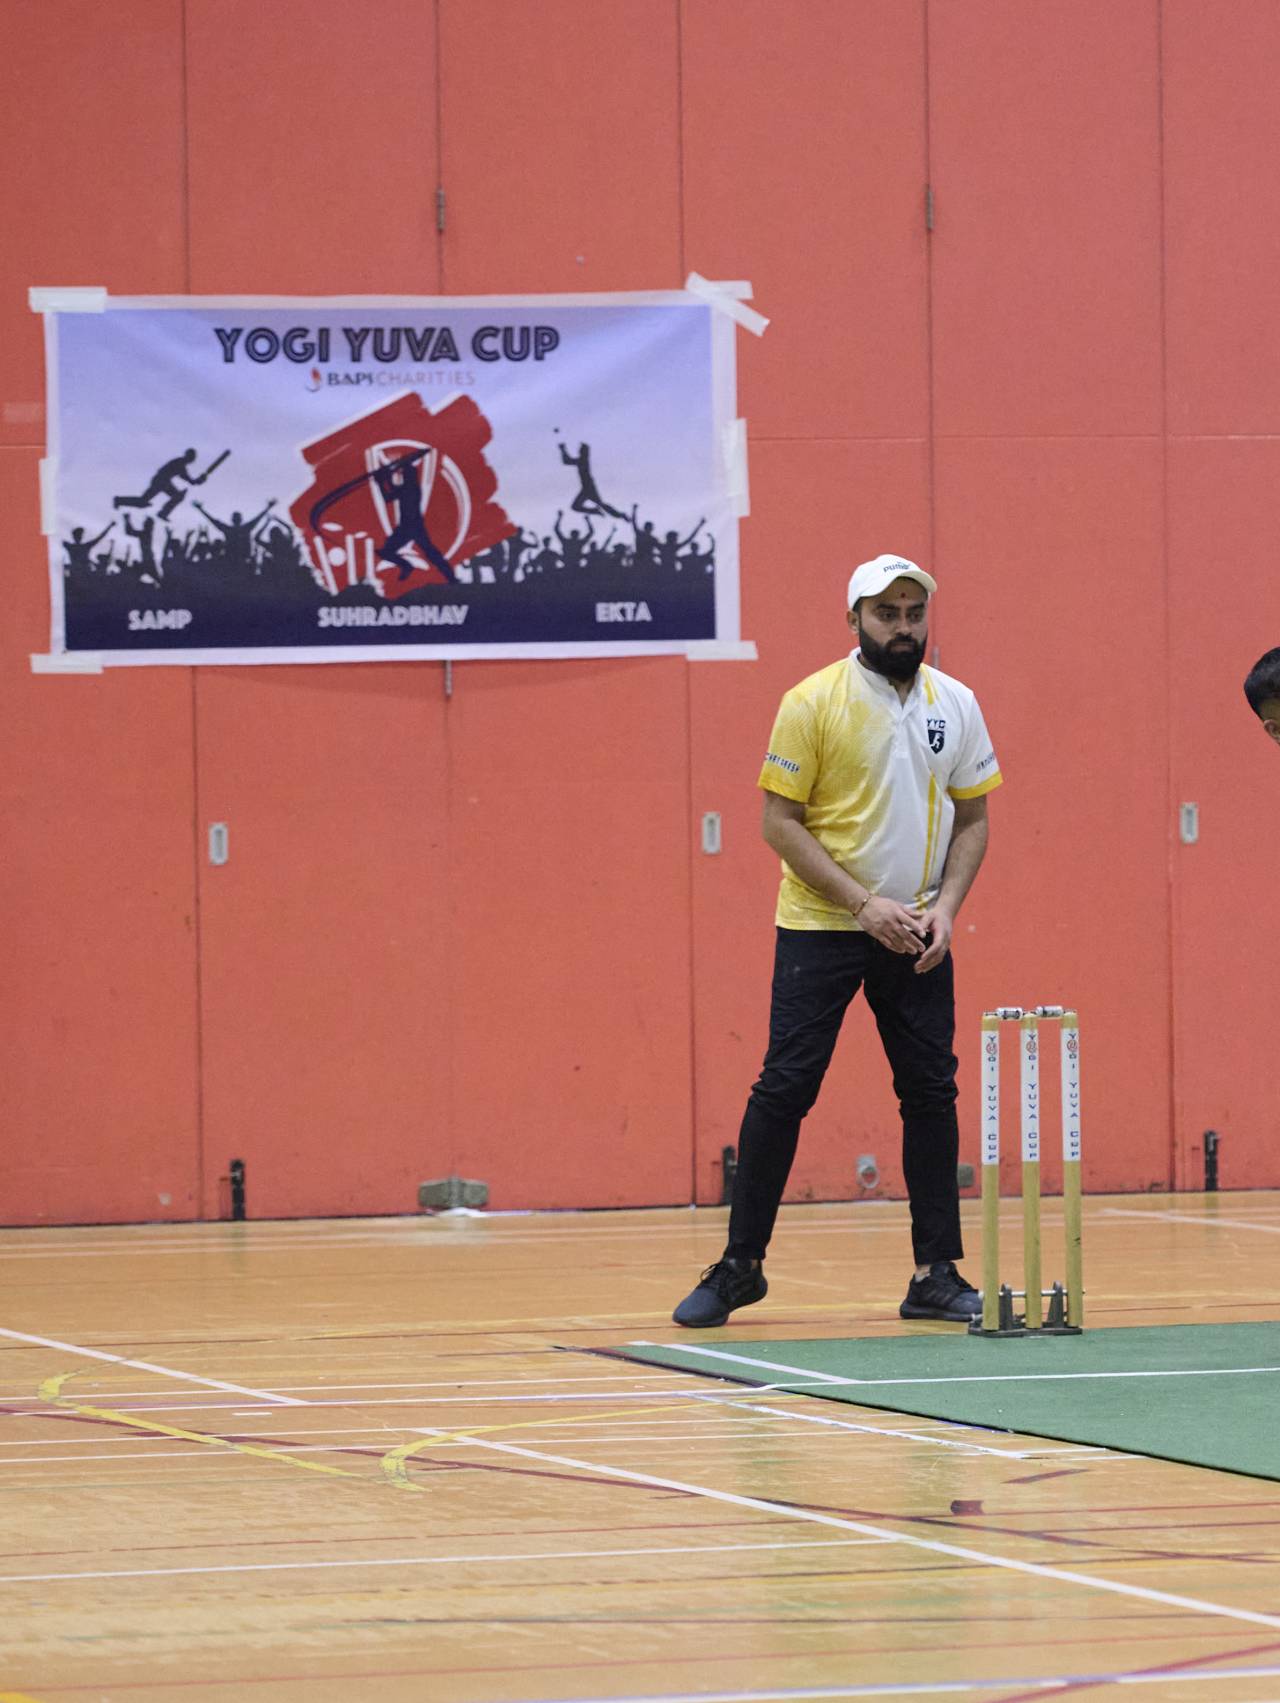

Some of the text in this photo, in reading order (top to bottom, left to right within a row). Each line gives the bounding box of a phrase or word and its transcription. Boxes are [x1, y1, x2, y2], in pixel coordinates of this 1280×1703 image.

[213, 325, 561, 363] YOGI YUVA CUP
[127, 608, 193, 631] SAMP
[317, 605, 470, 628] SUHRADBHAV
[594, 602, 653, 623] EKTA
[988, 1085, 997, 1120] YUVA
[1028, 1083, 1037, 1119] YUVA
[1069, 1081, 1078, 1118] YUVA
[988, 1134, 997, 1160] CUP
[1028, 1132, 1037, 1158] CUP
[1070, 1131, 1079, 1157] CUP
